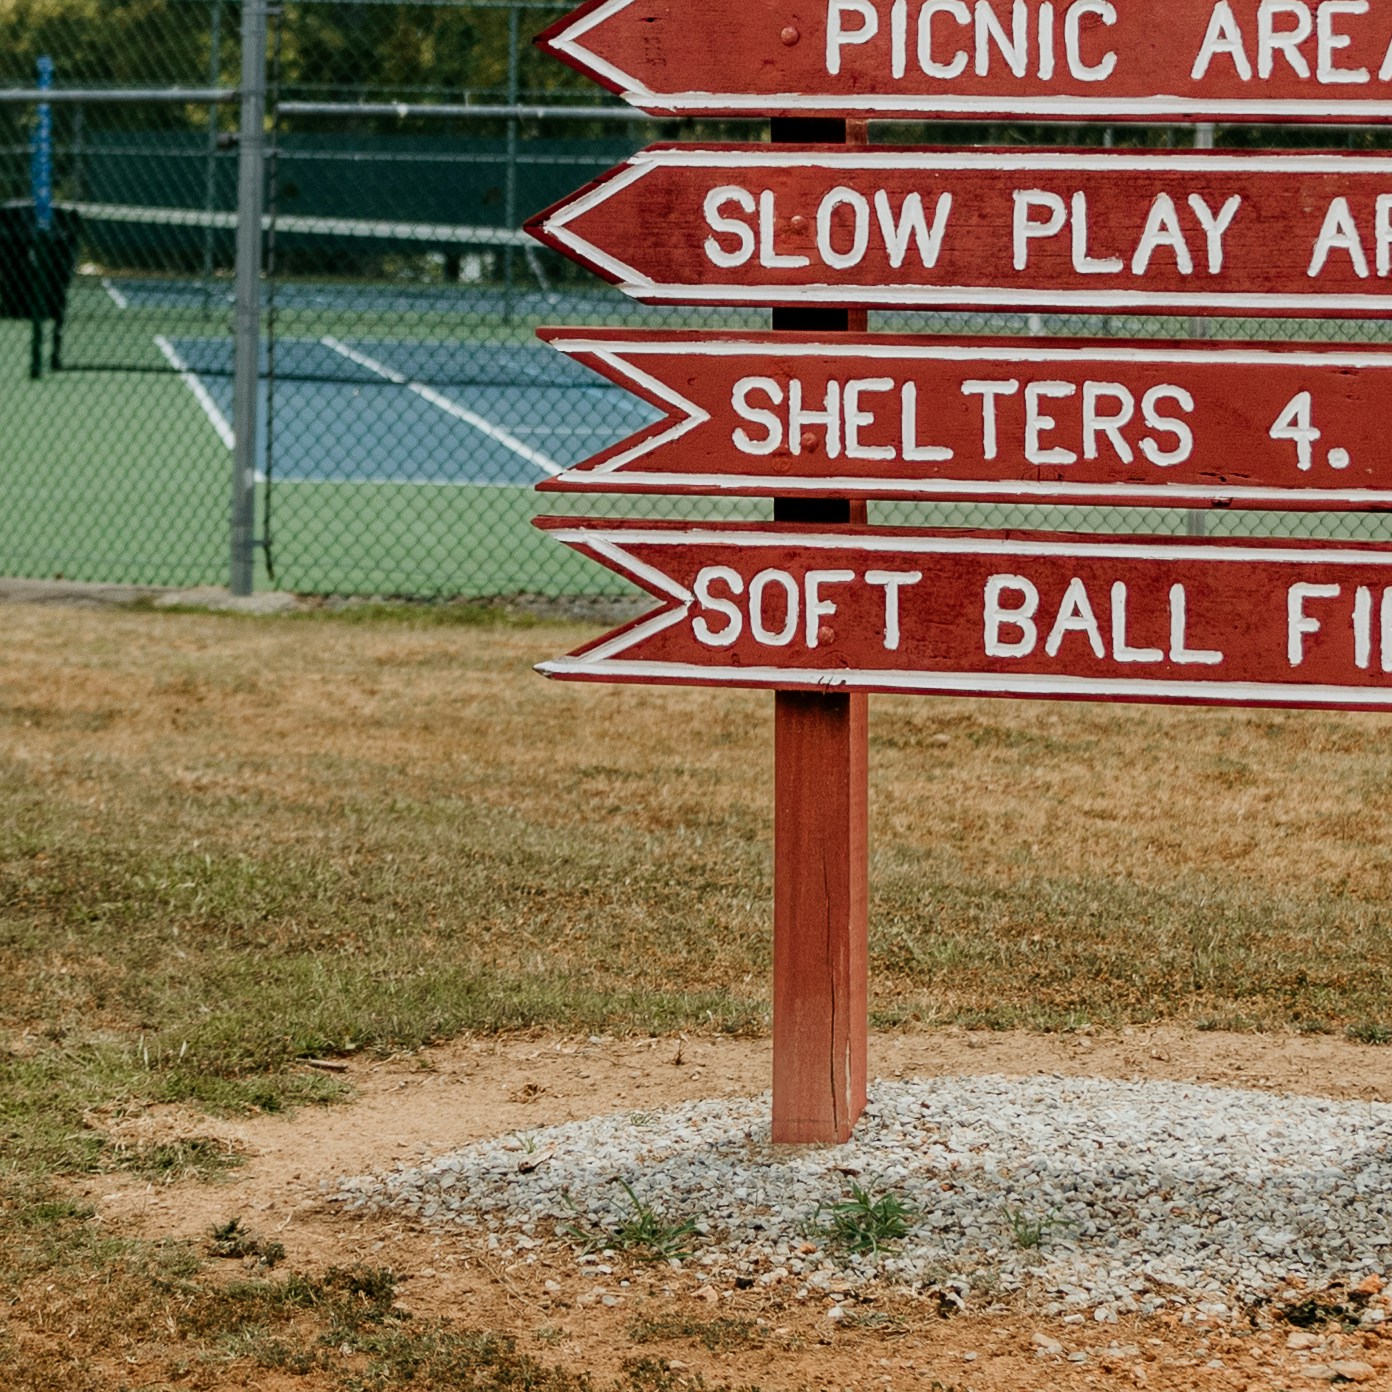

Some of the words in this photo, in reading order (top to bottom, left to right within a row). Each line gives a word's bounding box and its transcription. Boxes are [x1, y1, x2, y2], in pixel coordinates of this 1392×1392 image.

[704, 185, 952, 269] SLOW
[1013, 189, 1241, 275] PLAY
[731, 377, 1194, 466] SHELTERS
[1270, 392, 1349, 470] 4.
[692, 566, 922, 649] SOFT
[984, 574, 1223, 664] BALL
